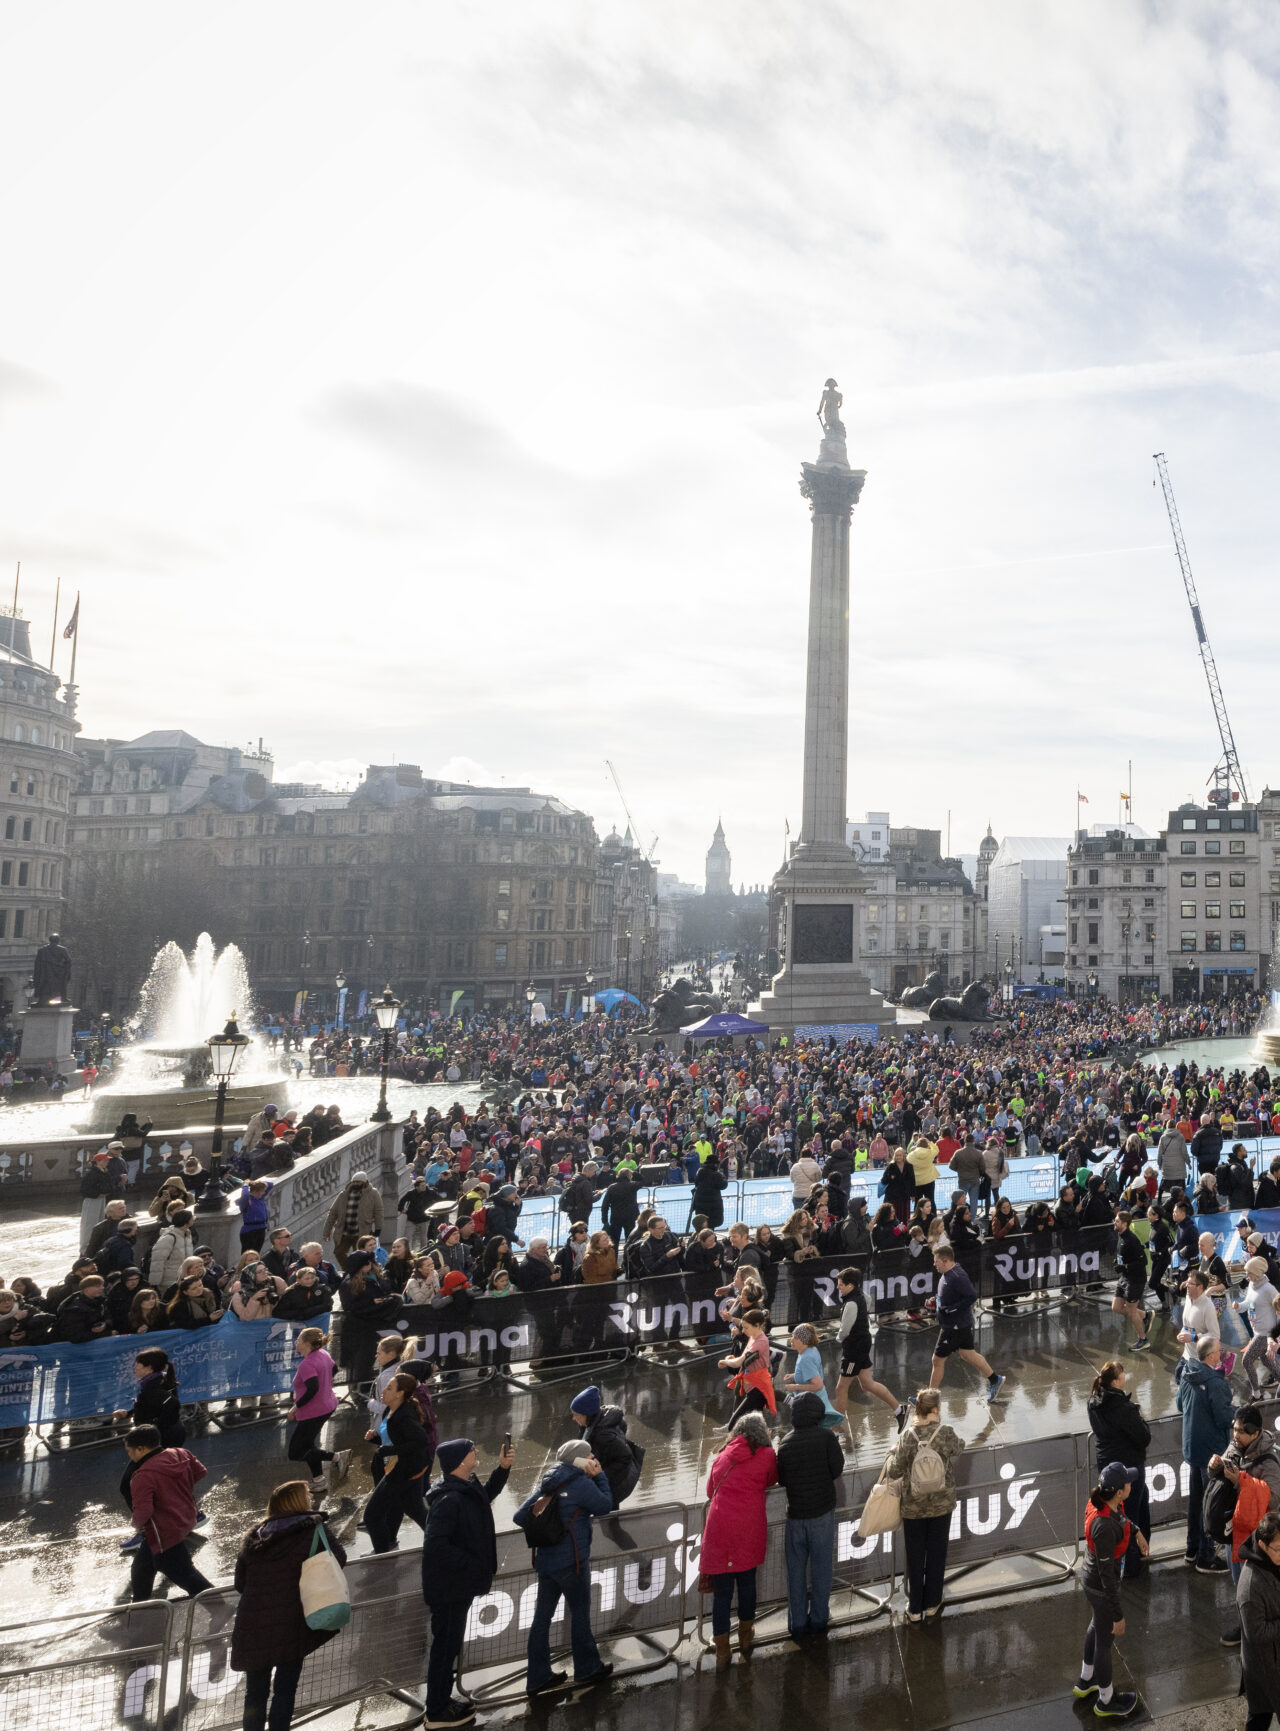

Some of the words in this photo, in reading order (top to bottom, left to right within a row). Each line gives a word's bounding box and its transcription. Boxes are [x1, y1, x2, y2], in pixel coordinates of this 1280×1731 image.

[994, 1245, 1100, 1282] Runna
[813, 1268, 933, 1307] Rnna
[265, 1349, 304, 1362] WINTE
